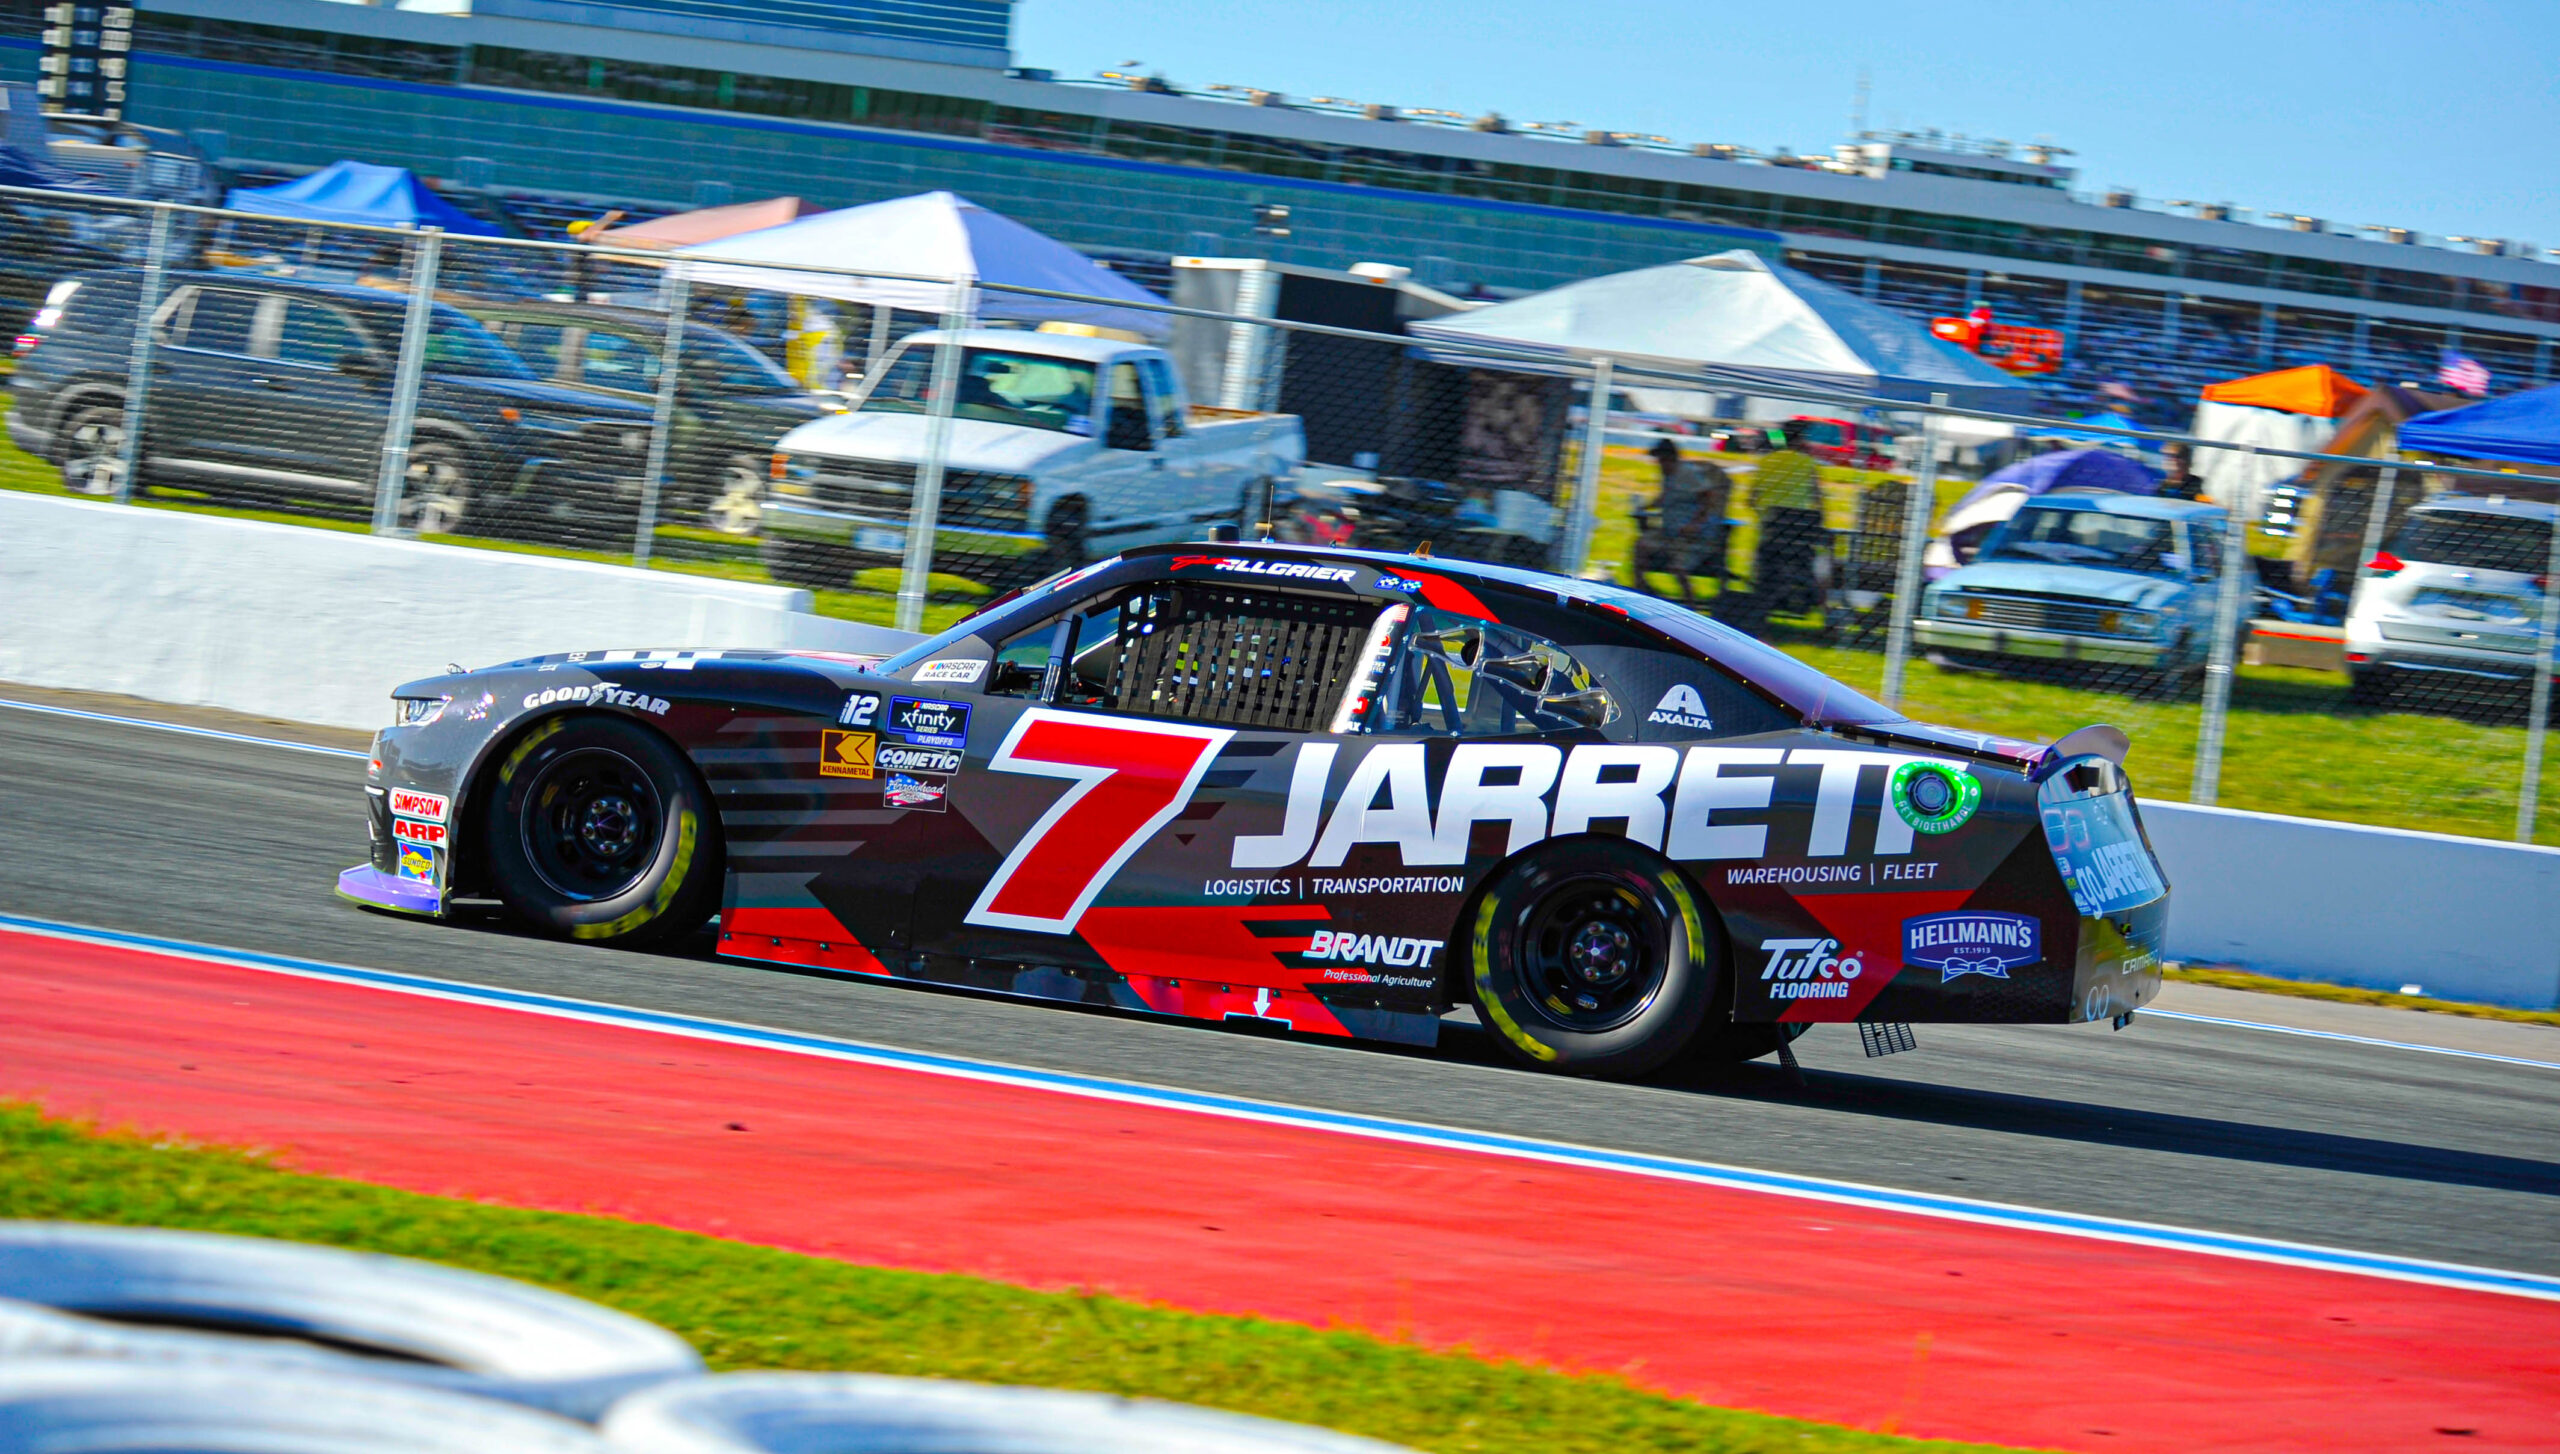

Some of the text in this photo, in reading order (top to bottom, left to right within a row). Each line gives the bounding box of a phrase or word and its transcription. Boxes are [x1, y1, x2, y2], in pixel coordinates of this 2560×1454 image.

[1215, 559, 1356, 582] ALLGAIER
[923, 671, 971, 679] RACE CAR
[939, 662, 977, 671] NASCAR
[901, 709, 956, 731] xfinity
[915, 725, 939, 734] SERIES
[1648, 711, 1712, 730] AXALTA
[916, 734, 954, 746] PLAYOFFS
[878, 748, 960, 770] COMETIC
[822, 764, 872, 777] KENNAMETAL
[394, 793, 443, 817] SIMPSON
[1231, 742, 1969, 868] JARRETT
[963, 707, 1237, 935] 7
[1898, 800, 1973, 832] GET BIOETHANOL
[395, 820, 445, 842] ARP
[402, 856, 432, 871] SUNOCO
[1727, 863, 1938, 884] WAREHOUSING FLEET
[1204, 876, 1464, 896] LOGISTICS TRANSPORTATION
[1911, 919, 2031, 950] HELLMANN'S
[1302, 930, 1444, 968] BRANDT
[1760, 938, 1862, 980] Tufco
[1953, 947, 1991, 955] EST.1913
[1324, 969, 1433, 988] Professional Agriculture
[1769, 982, 1849, 999] FLOORING
